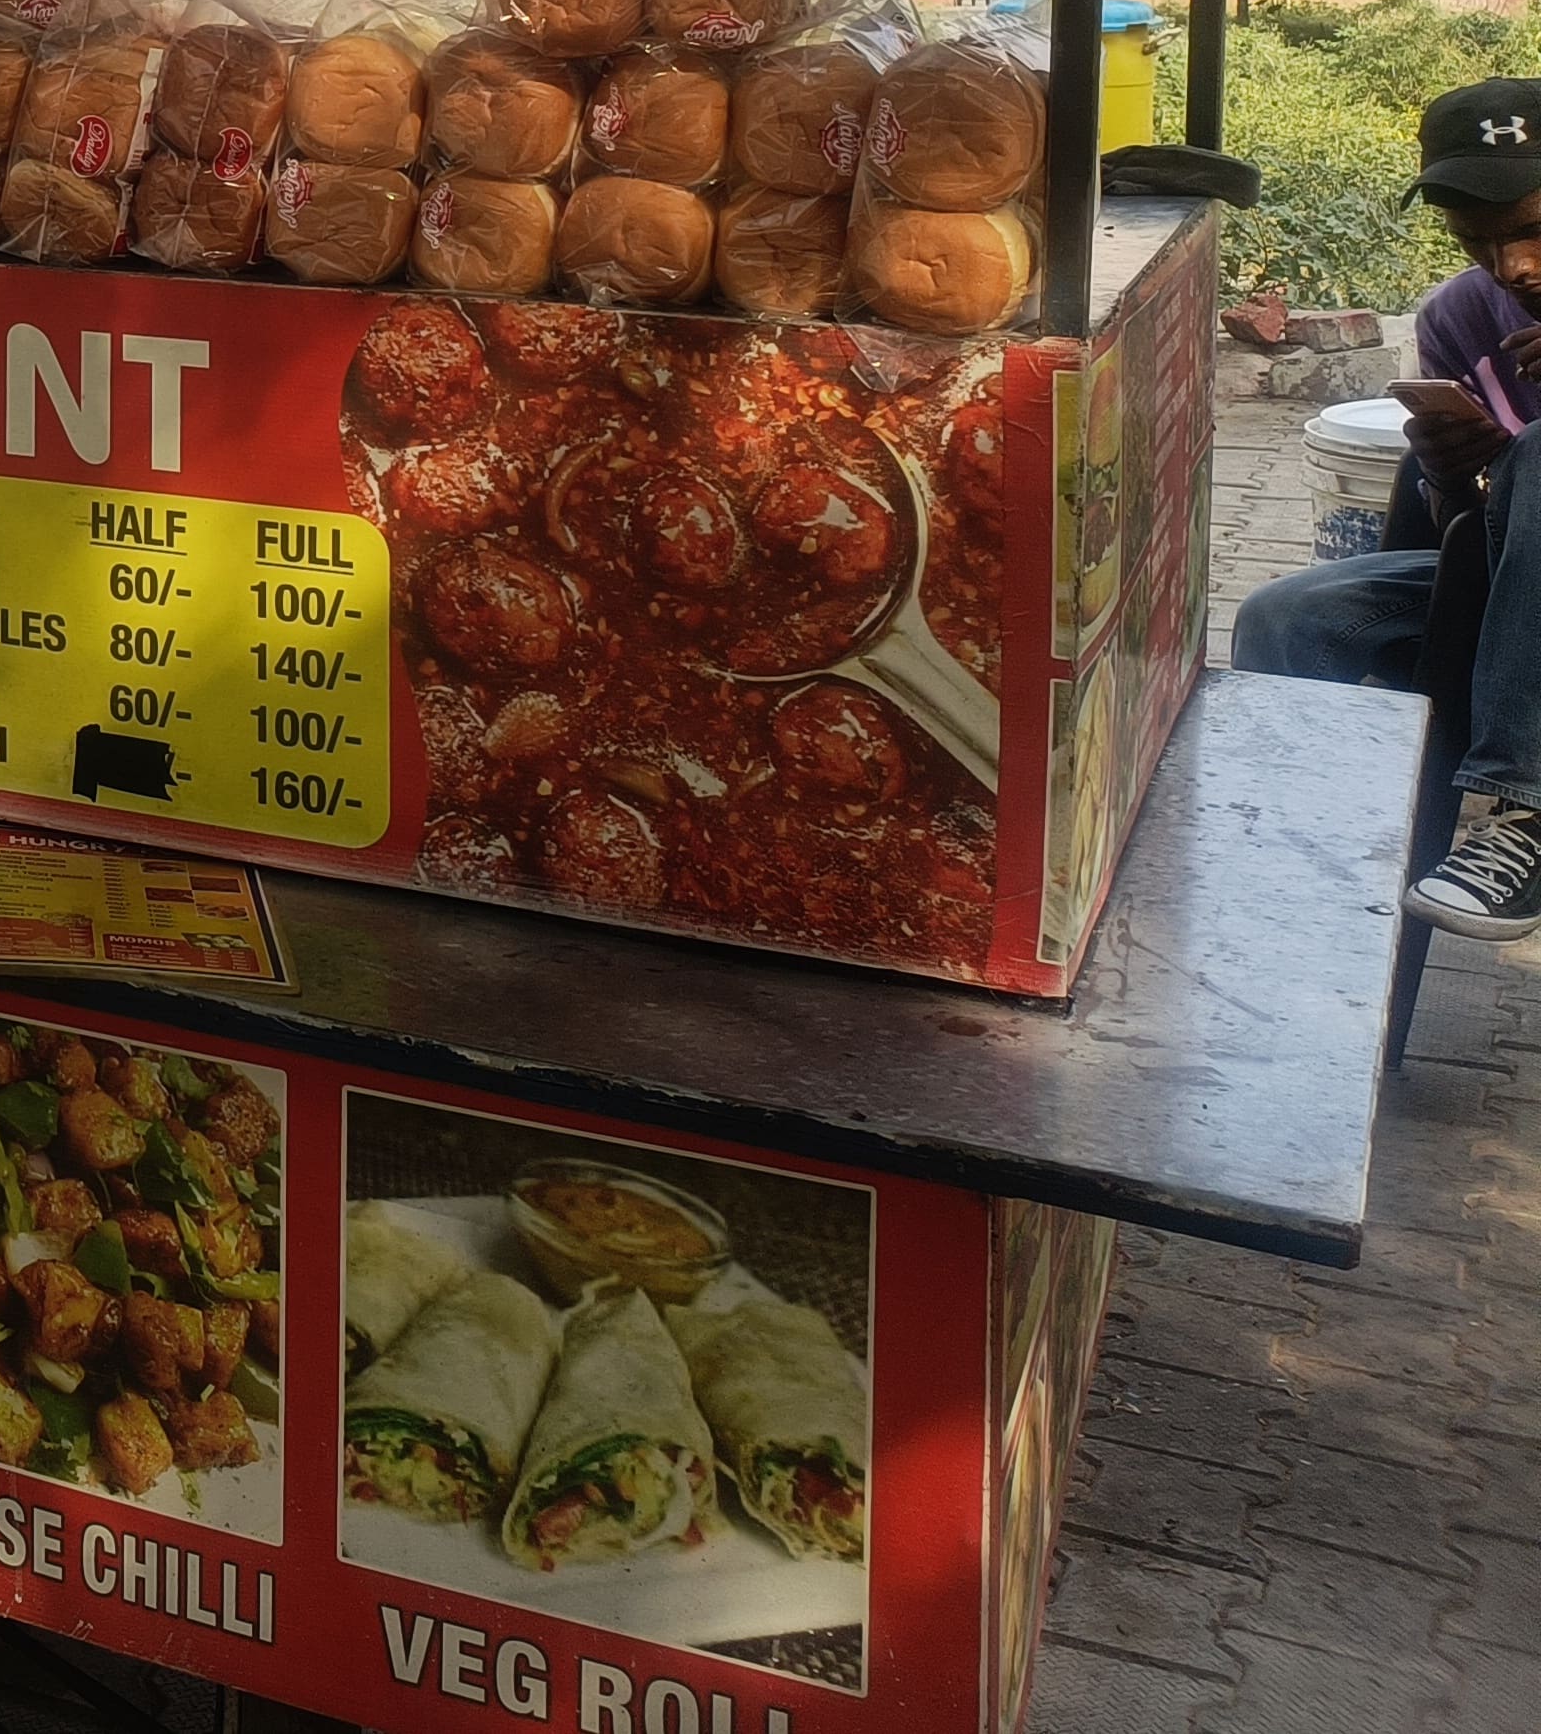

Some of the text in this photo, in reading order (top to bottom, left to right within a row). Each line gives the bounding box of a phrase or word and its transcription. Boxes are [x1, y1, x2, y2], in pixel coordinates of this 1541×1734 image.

[89, 500, 354, 571] HALF FULL
[108, 563, 193, 608] 60/-
[250, 580, 362, 631] 100/-
[109, 624, 193, 668] 80/-
[250, 642, 362, 693] 140/-
[109, 684, 193, 729] 60/-
[250, 704, 363, 756] 100/-
[251, 767, 363, 816] 160/-
[109, 935, 176, 947] MOMOS
[81, 1524, 275, 1645] CHILLI
[379, 1604, 551, 1724] VEG
